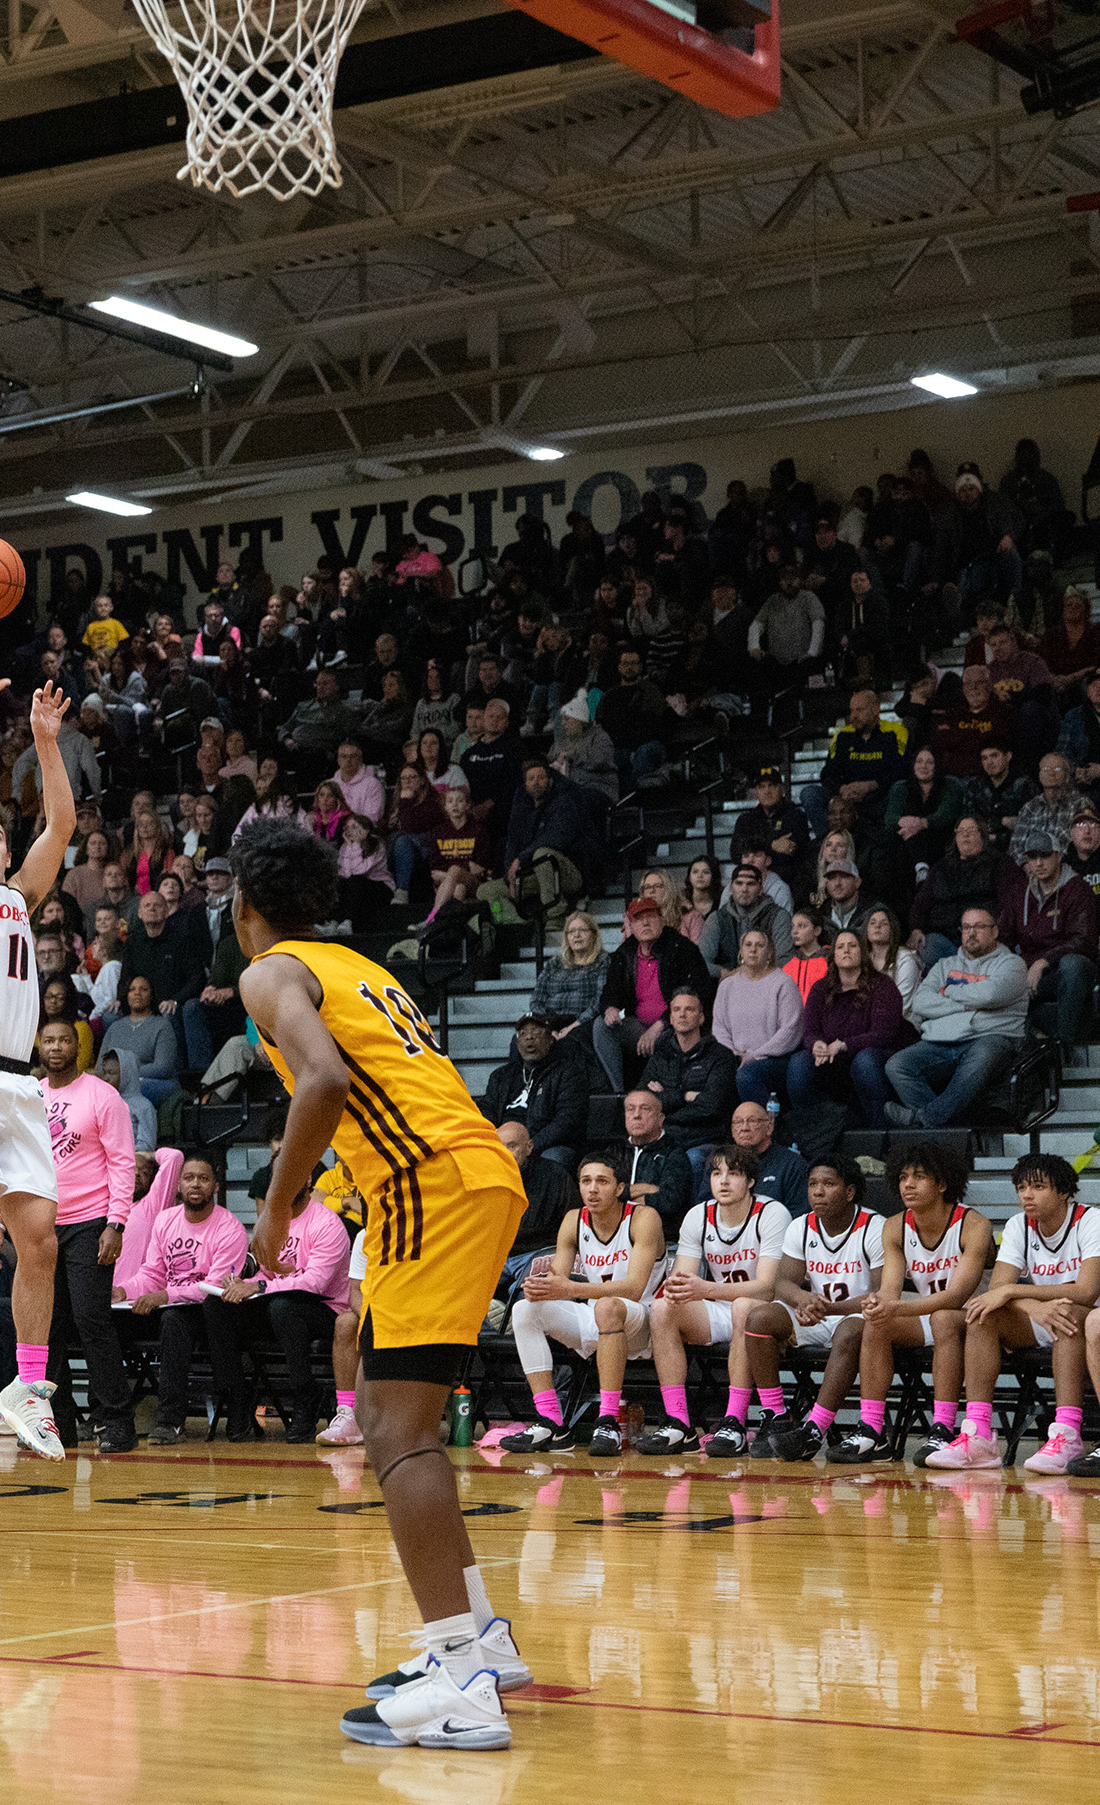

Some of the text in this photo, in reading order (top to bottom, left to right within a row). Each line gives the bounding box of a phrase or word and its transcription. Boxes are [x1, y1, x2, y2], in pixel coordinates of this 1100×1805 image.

[311, 461, 713, 570] VISITOR
[7, 933, 28, 981] 11
[59, 1131, 82, 1158] CURE
[808, 1260, 862, 1275] BOBCATS
